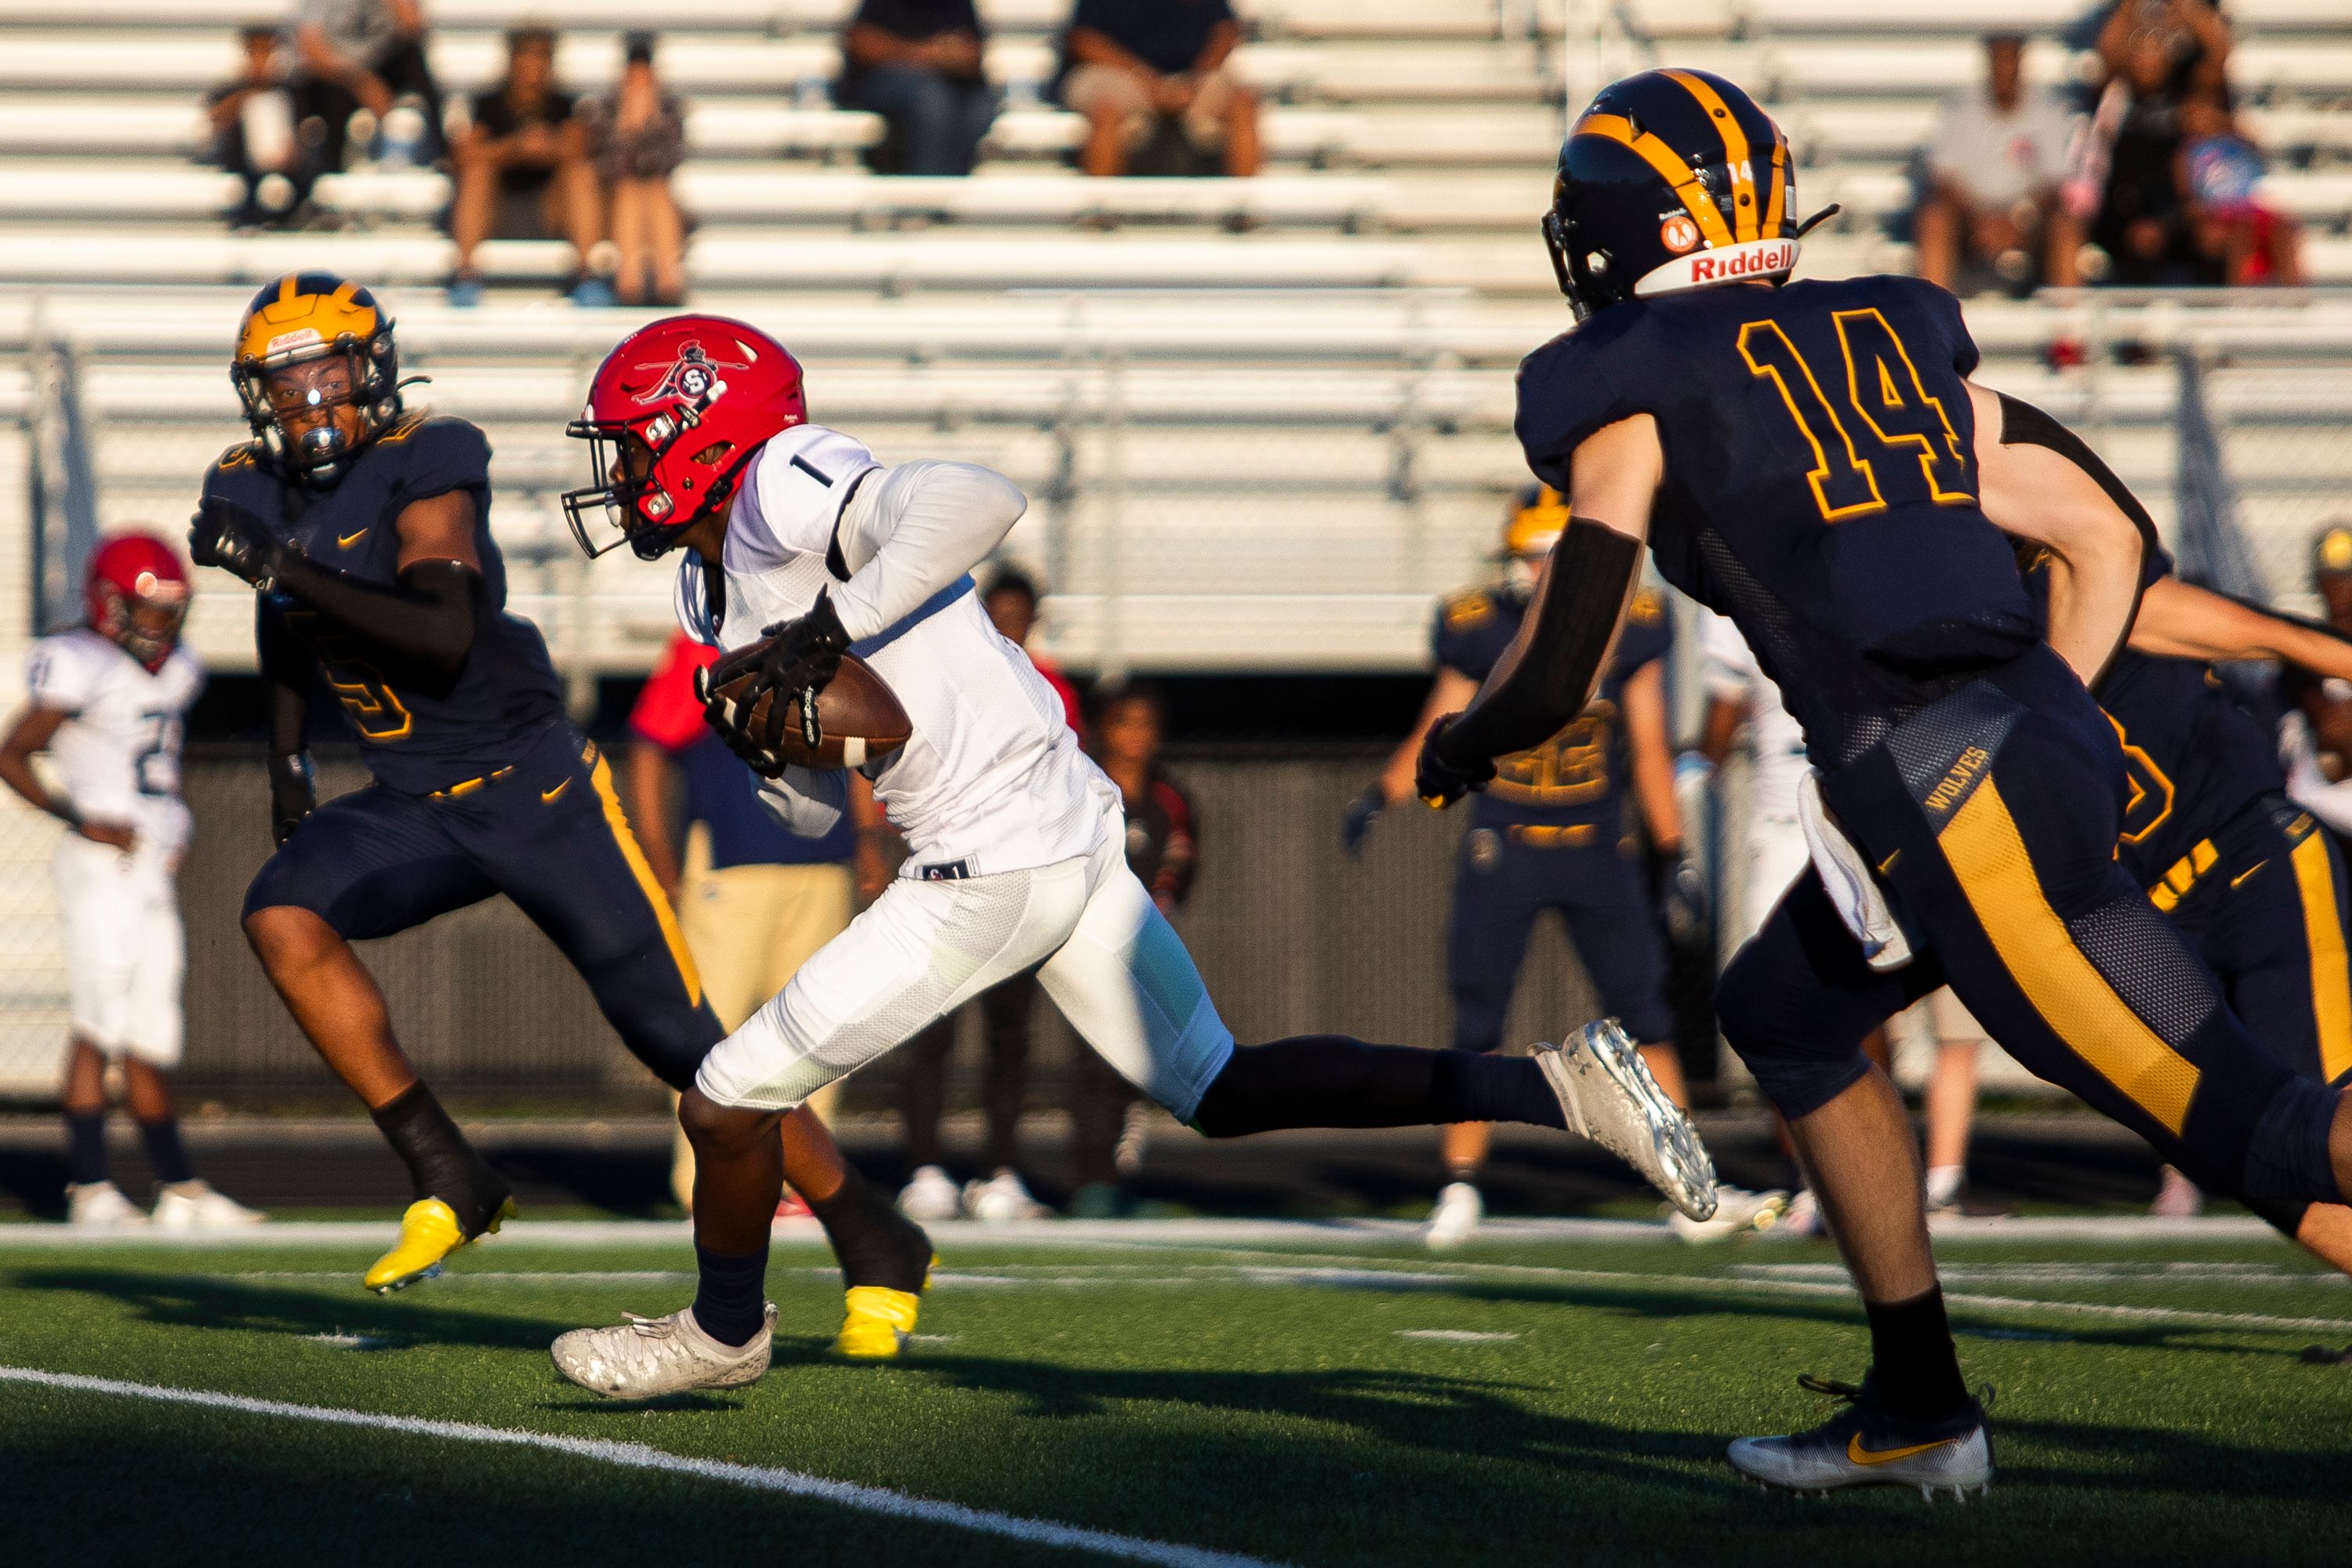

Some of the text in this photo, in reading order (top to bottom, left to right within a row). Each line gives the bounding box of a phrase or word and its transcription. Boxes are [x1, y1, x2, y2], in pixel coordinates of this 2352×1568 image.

[1727, 160, 1754, 184] 14
[1691, 244, 1792, 282] Riddell
[1736, 307, 1976, 519] 14
[789, 452, 834, 488] 1
[1924, 746, 1987, 809] WOLVES
